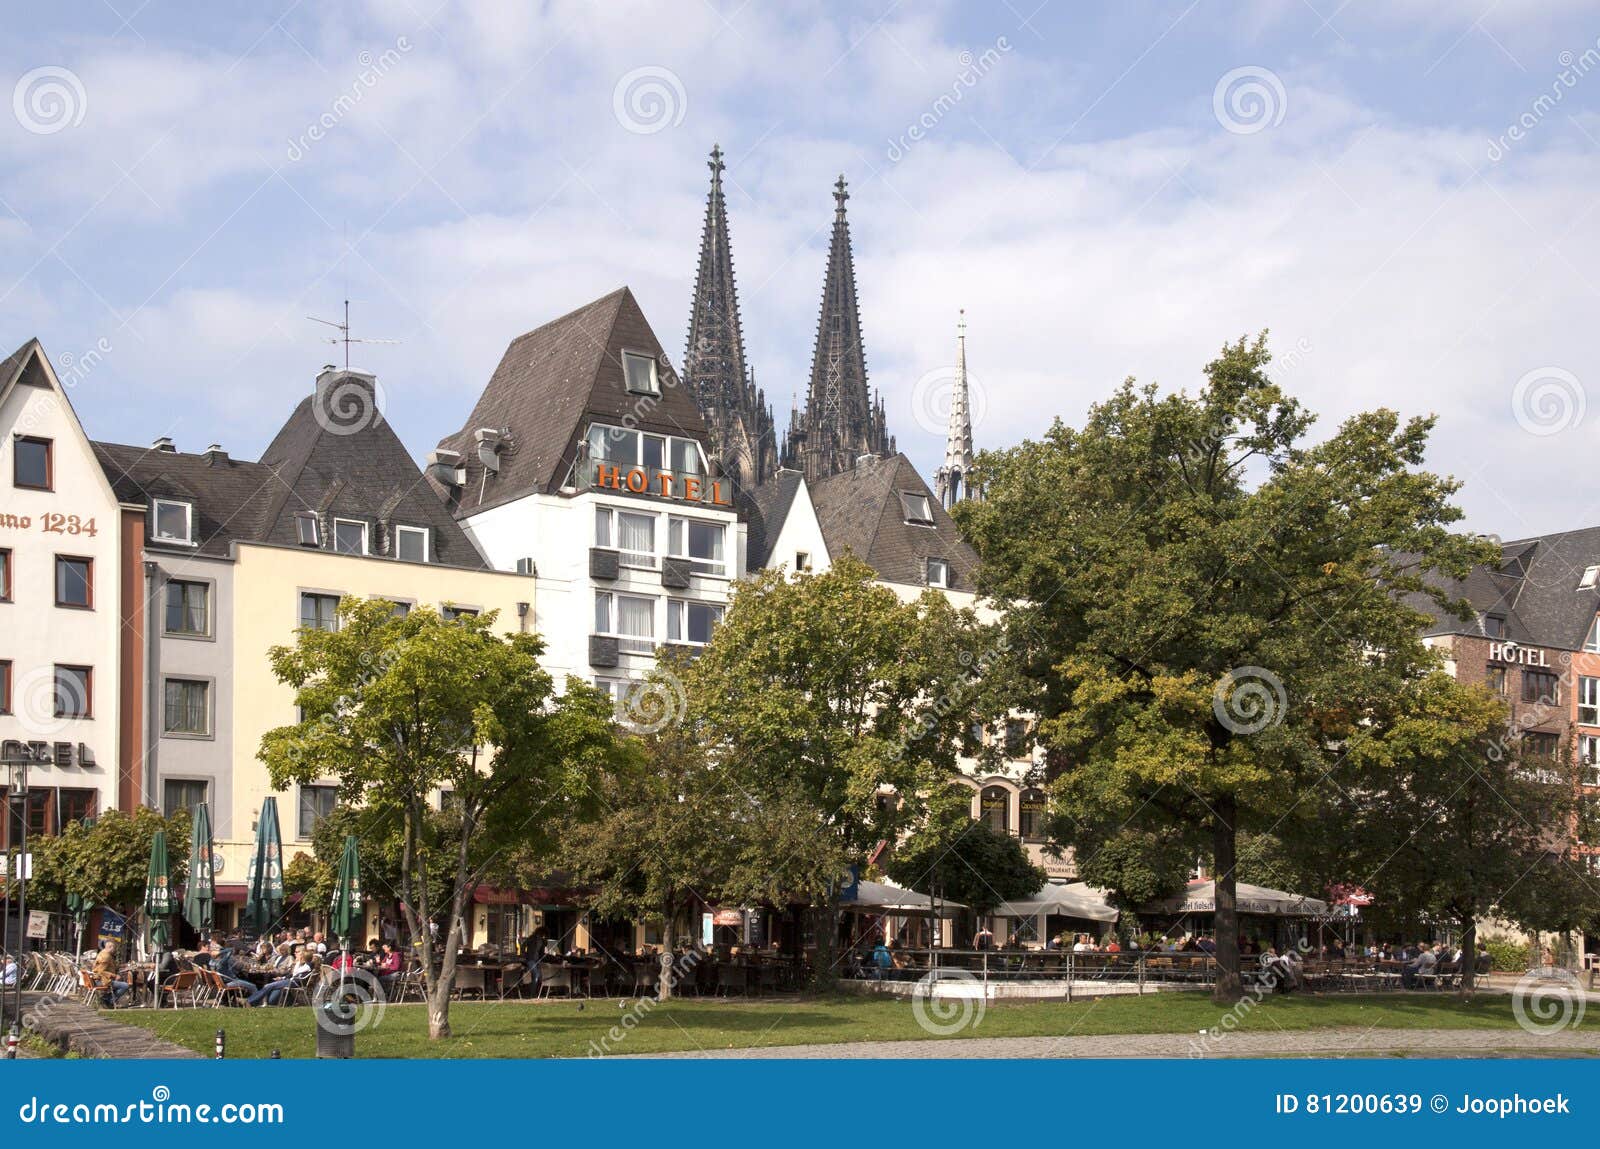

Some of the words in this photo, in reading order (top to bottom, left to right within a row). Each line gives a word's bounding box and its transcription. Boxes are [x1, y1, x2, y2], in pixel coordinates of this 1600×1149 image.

[597, 464, 729, 505] HOTEL
[40, 512, 98, 537] 1234
[1489, 643, 1551, 668] HOTEL
